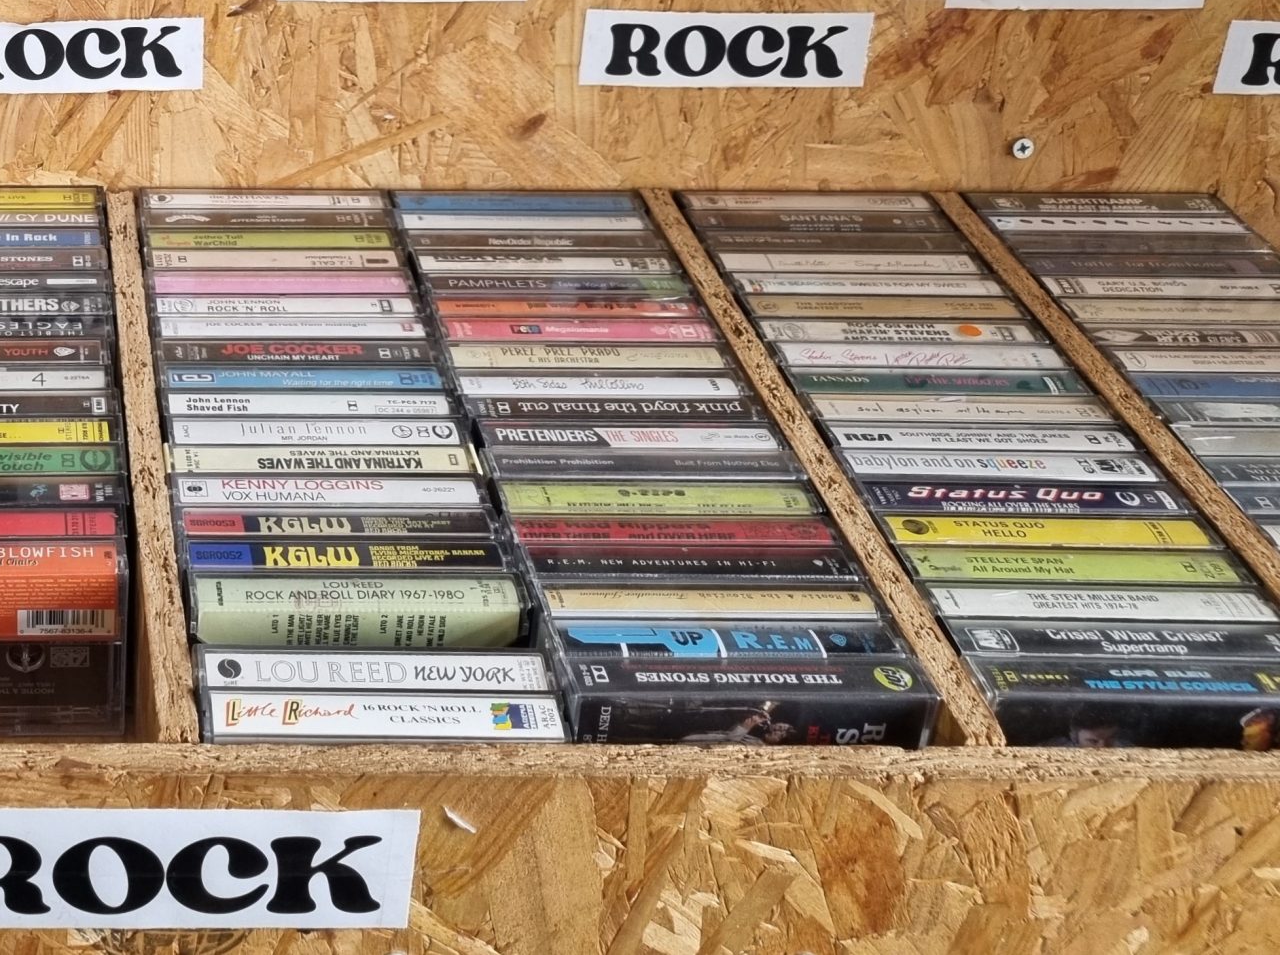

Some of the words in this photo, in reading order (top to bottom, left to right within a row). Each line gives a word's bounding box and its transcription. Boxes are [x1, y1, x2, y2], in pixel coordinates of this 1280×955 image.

[605, 23, 849, 77] ROCK
[15, 214, 38, 222] CY
[44, 214, 94, 222] DUNE
[6, 233, 19, 241] In
[24, 233, 57, 241] Rock
[222, 345, 264, 354] JOE
[270, 345, 363, 354] COCKER
[496, 428, 598, 442] PRETENDERS
[604, 429, 626, 442] THE
[630, 430, 679, 443] SINGLES
[852, 454, 918, 468] babylon
[921, 455, 949, 468] and
[953, 458, 974, 468] on
[977, 457, 1047, 473] squeeze
[222, 479, 291, 490] KENNY
[295, 480, 384, 490] LOGGINS
[223, 491, 253, 501] VOX
[256, 491, 326, 501] HUMANA
[908, 486, 1028, 500] Status
[1038, 489, 1104, 501] Quo
[258, 517, 351, 533] KGLW
[954, 520, 1009, 530] STATUS
[1013, 520, 1045, 530] QUO
[982, 529, 1027, 539] HELLO
[264, 546, 360, 567] KGLW
[246, 591, 284, 600] ROCK
[289, 591, 315, 600] AND
[321, 590, 352, 599] ROLL
[357, 590, 395, 599] DIARY
[399, 590, 465, 599] 1967-1980
[1102, 641, 1188, 655] Supertramp
[256, 661, 319, 682] LOU
[328, 661, 407, 683] REED
[413, 665, 457, 681] NEW
[460, 668, 515, 683] YORK
[390, 716, 461, 724] CLASSICS
